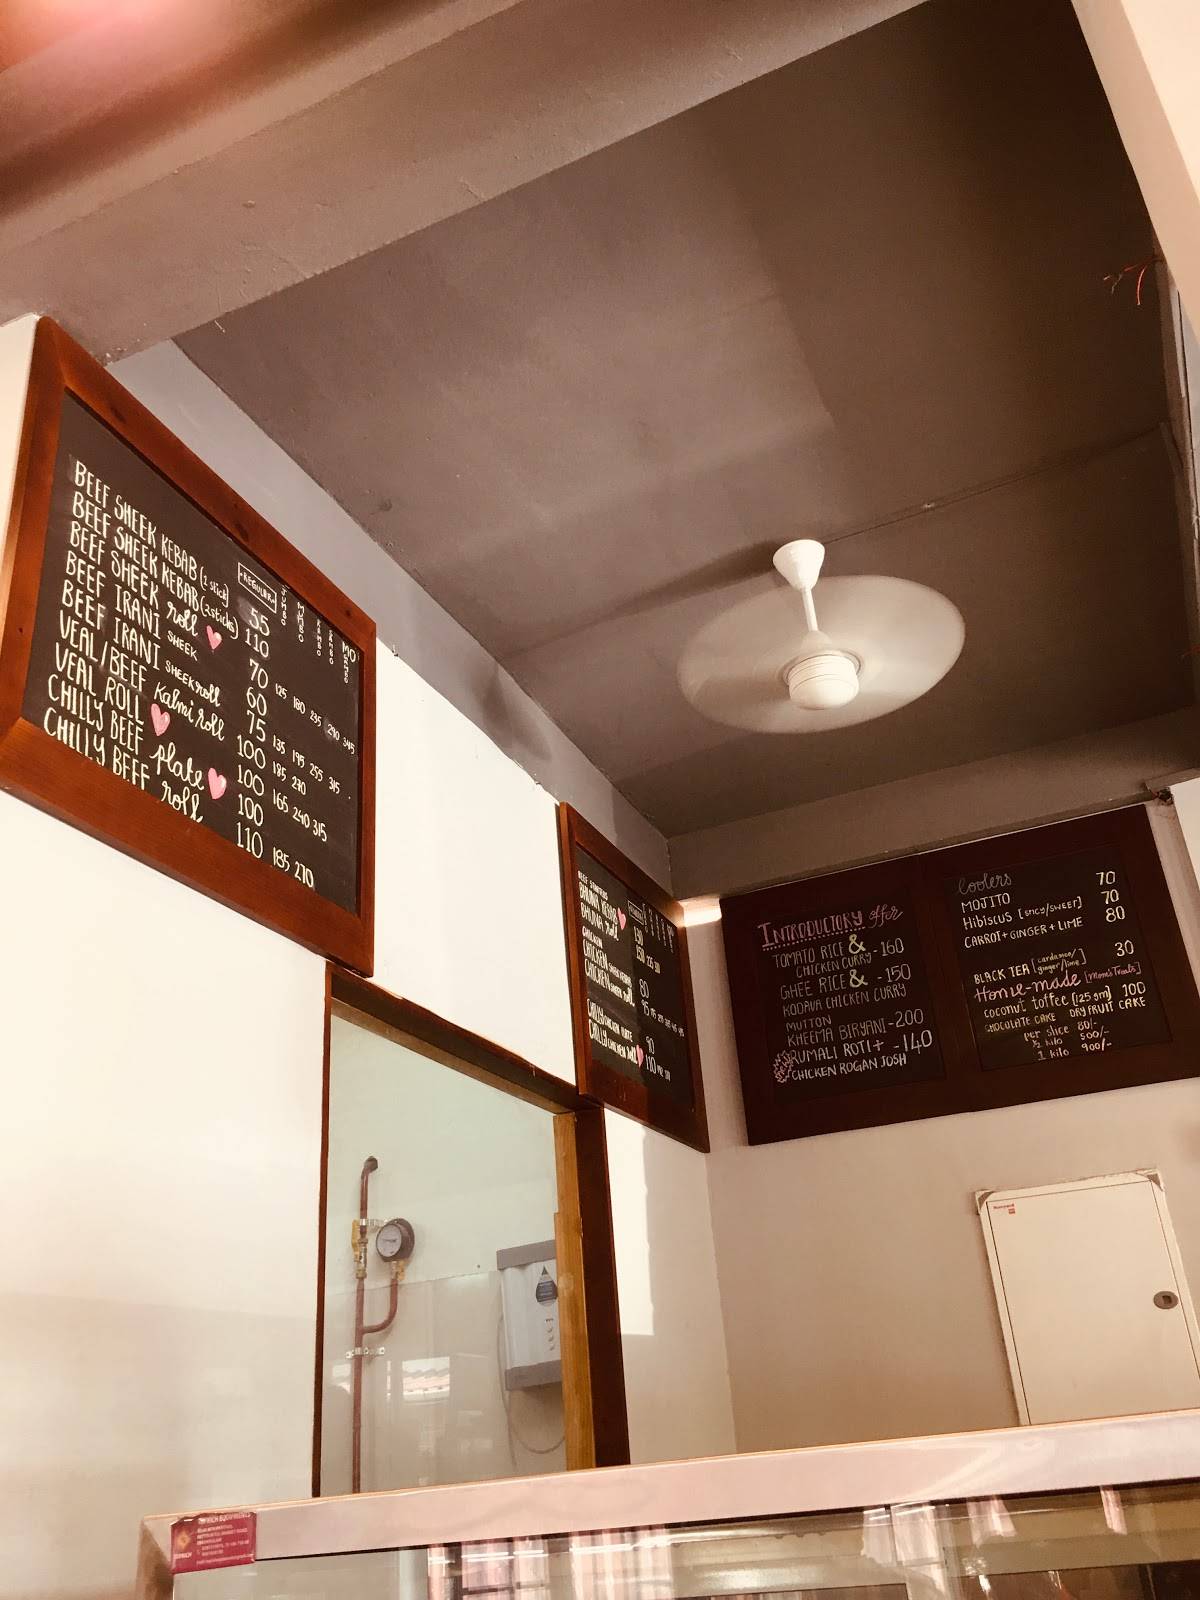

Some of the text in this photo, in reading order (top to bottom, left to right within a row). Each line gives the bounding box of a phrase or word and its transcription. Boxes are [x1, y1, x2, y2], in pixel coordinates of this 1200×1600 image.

[74, 460, 110, 508] BEEF
[114, 494, 156, 549] SHEEK
[161, 534, 197, 581] KEBAB
[250, 607, 270, 636] 55
[73, 491, 111, 538] BEEF
[114, 526, 157, 578] SHEEK
[162, 562, 199, 612] KEBAB
[245, 628, 270, 658] 110
[66, 550, 267, 716] BEEF IRANI SHEEK 60
[70, 521, 105, 565] BEEF
[111, 550, 159, 610] SHEEK
[249, 659, 269, 689] 70
[275, 683, 288, 700] 125
[309, 710, 322, 727] 235
[327, 724, 340, 741] 290
[342, 737, 356, 755] 345
[62, 580, 107, 630] BEEF
[113, 617, 160, 670] IRANI
[247, 709, 266, 742] 75
[273, 735, 286, 755] 135
[292, 750, 305, 768] 195
[309, 763, 323, 782] 255
[329, 777, 340, 794] 315
[48, 674, 104, 731] CHILLY
[110, 710, 144, 755] BEEF
[238, 794, 264, 827] 100
[56, 642, 328, 842] VEAL ROLL 100 165 240 315
[237, 734, 266, 769] 100
[273, 761, 287, 781] 185
[292, 776, 307, 796] 270
[113, 745, 150, 790] BEEF
[236, 822, 263, 859] 110
[273, 847, 290, 872] 185
[295, 861, 314, 888] 270
[1095, 871, 1116, 885] 70
[961, 889, 1119, 913] MOJITO 70
[1106, 905, 1126, 923] 80
[773, 947, 816, 968] TOMATO
[820, 941, 845, 960] RICE
[848, 934, 866, 954] &
[796, 952, 872, 978] CHICKEN CURRY
[974, 940, 1134, 985] BLACK TEA 30
[780, 981, 813, 1000] GHEE
[819, 974, 846, 993] RICE
[849, 969, 868, 988] &
[826, 991, 869, 1009] CHICKEN
[874, 983, 907, 1002] CURRY
[1122, 981, 1146, 997] 100
[786, 1014, 832, 1032] MUTTON
[1034, 1012, 1056, 1025] CAKE
[1069, 1006, 1086, 1018] DRY
[1088, 1002, 1114, 1015] FRUIT
[1118, 997, 1147, 1010] CAKE
[787, 1027, 834, 1047] KHEEMA
[838, 1018, 887, 1040] BIRYANI
[1046, 1025, 1070, 1037] slice
[790, 1046, 838, 1065] RUMALI
[843, 1039, 872, 1057] ROTI
[1050, 1048, 1070, 1059] kilo
[791, 1053, 907, 1081] CHICKEN ROGAN JOSH
